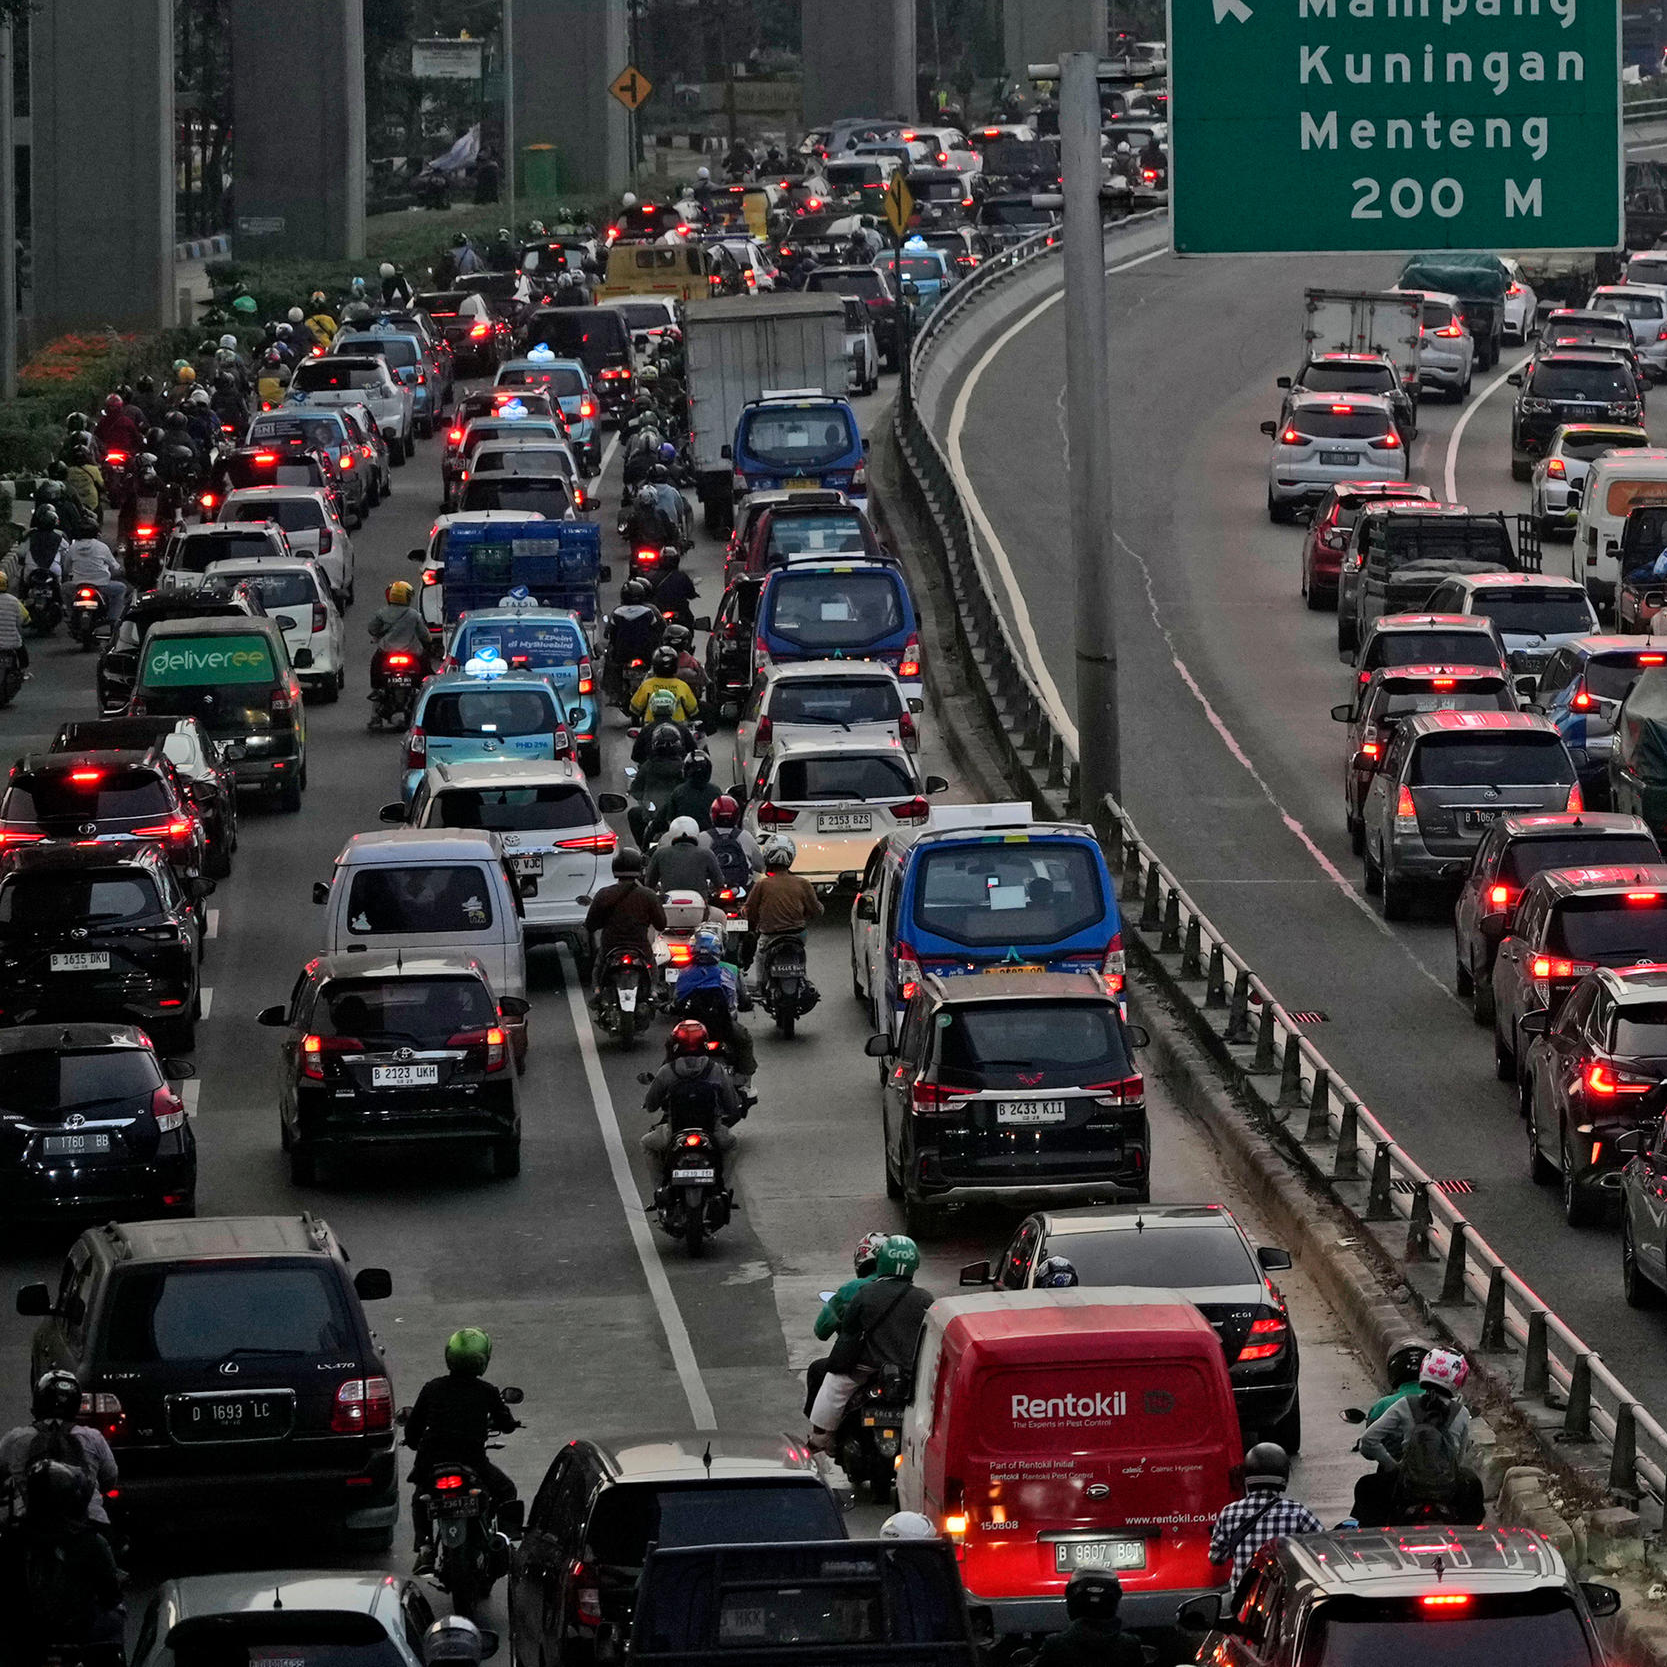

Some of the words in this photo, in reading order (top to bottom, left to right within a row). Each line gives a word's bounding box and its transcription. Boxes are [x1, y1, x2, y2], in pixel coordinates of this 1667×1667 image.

[1297, 43, 1585, 95] Kuningan
[1297, 111, 1550, 160] Menteng
[1350, 177, 1464, 219] 200
[1504, 178, 1543, 217] M
[151, 650, 265, 674] deliveree
[829, 815, 850, 824] 2153
[374, 1068, 381, 1079] B
[386, 1067, 410, 1079] 2123
[416, 1066, 436, 1078] UKH
[999, 1104, 1005, 1115] B
[1011, 1103, 1037, 1115] 2433
[62, 1136, 85, 1148] 1760
[97, 1135, 109, 1147] BB
[887, 1248, 915, 1260] Grab
[1011, 1392, 1126, 1419] Rentokil
[193, 1407, 201, 1421] D
[213, 1405, 243, 1418] 1693
[253, 1403, 271, 1417] LC
[1012, 1421, 1027, 1429] The
[1028, 1420, 1055, 1430] Experts
[1066, 1419, 1083, 1428] Pest
[1084, 1418, 1112, 1427] Control
[990, 1461, 1009, 1470] Part
[1010, 1461, 1018, 1469] of
[1020, 1460, 1052, 1469] Rentokil
[1053, 1460, 1074, 1469] Initial
[1174, 1463, 1203, 1472] Hygiene
[1022, 1471, 1051, 1480] Rentokil
[1052, 1471, 1067, 1479] Pest
[1069, 1471, 1094, 1479] Control
[1125, 1513, 1217, 1525] www.rentokil.co.id
[981, 1521, 1019, 1530] 150808
[1058, 1546, 1066, 1561] B
[1076, 1545, 1106, 1559] 9607
